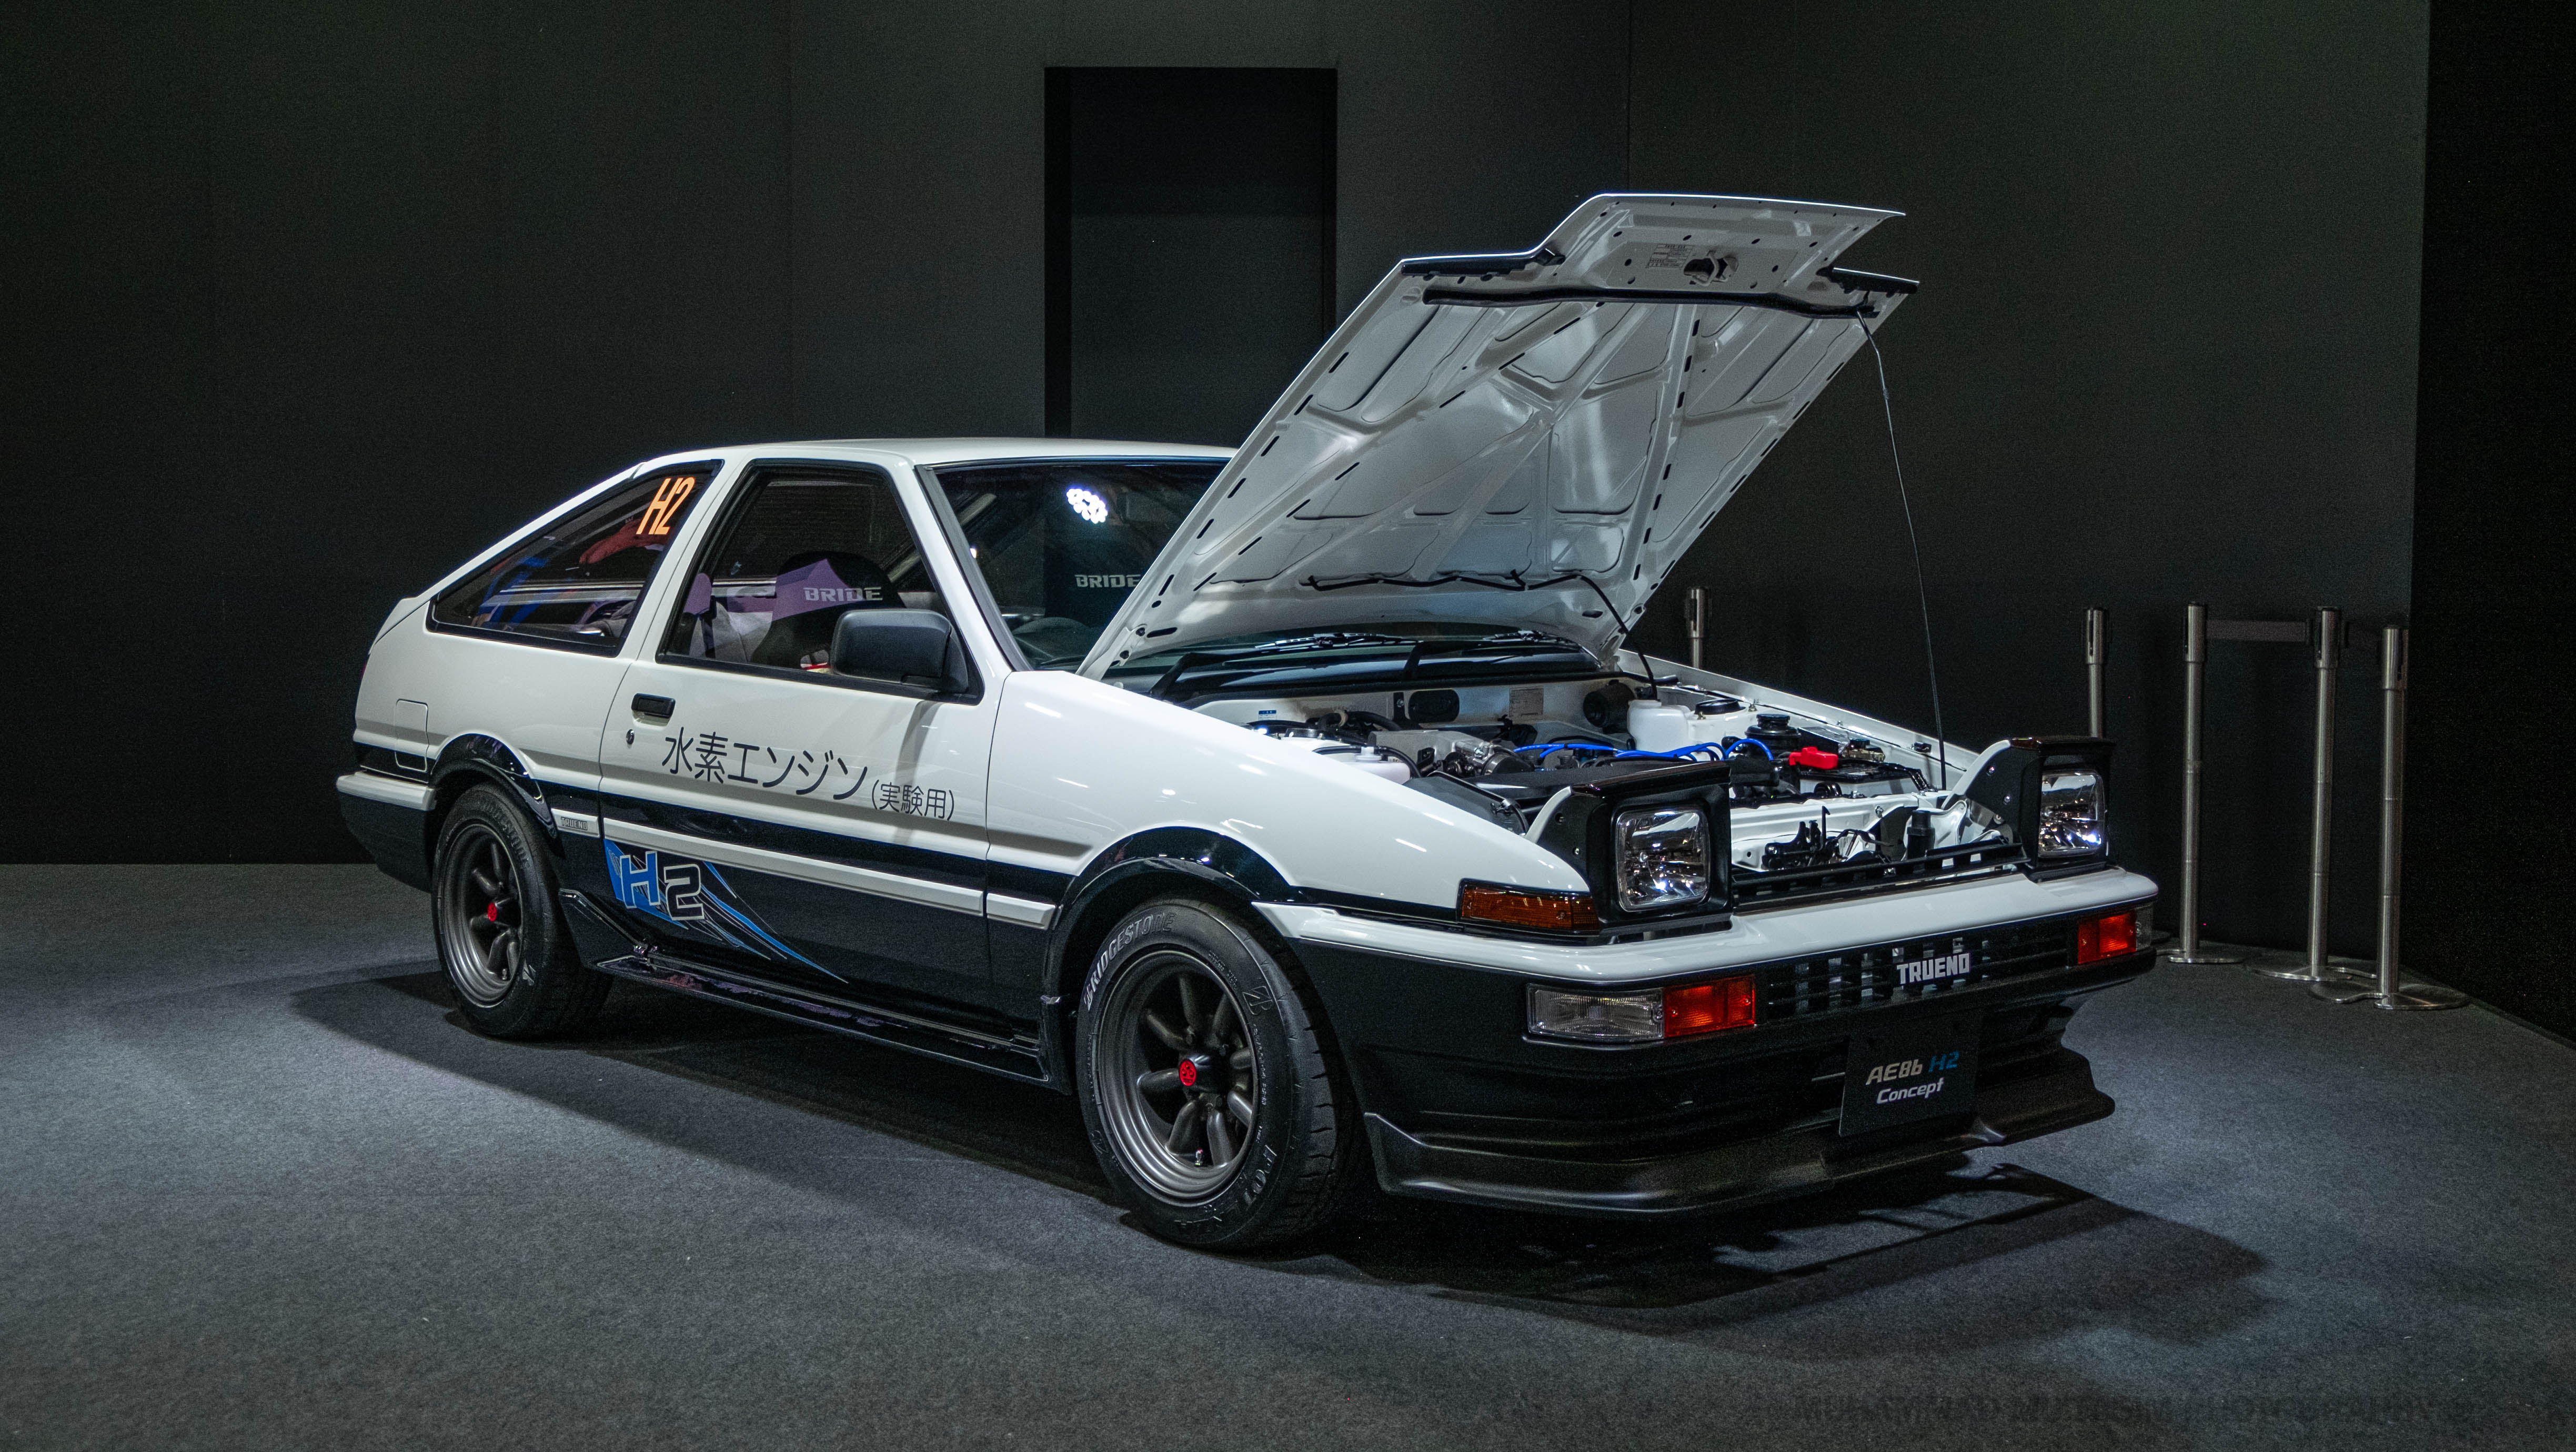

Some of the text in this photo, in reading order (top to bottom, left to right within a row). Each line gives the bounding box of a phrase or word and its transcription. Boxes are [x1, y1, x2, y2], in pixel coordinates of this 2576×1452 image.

[636, 477, 696, 535] H2
[804, 587, 883, 602] BRIDE
[1074, 574, 1142, 588] BRIDE
[561, 816, 588, 831] TRUENO
[620, 850, 705, 921] H2
[1084, 912, 1175, 1011] BRIDGESTONE
[1897, 953, 1971, 985] TRUENO
[1866, 1051, 1960, 1086] AE86 H2
[1876, 1076, 1945, 1105] Concept
